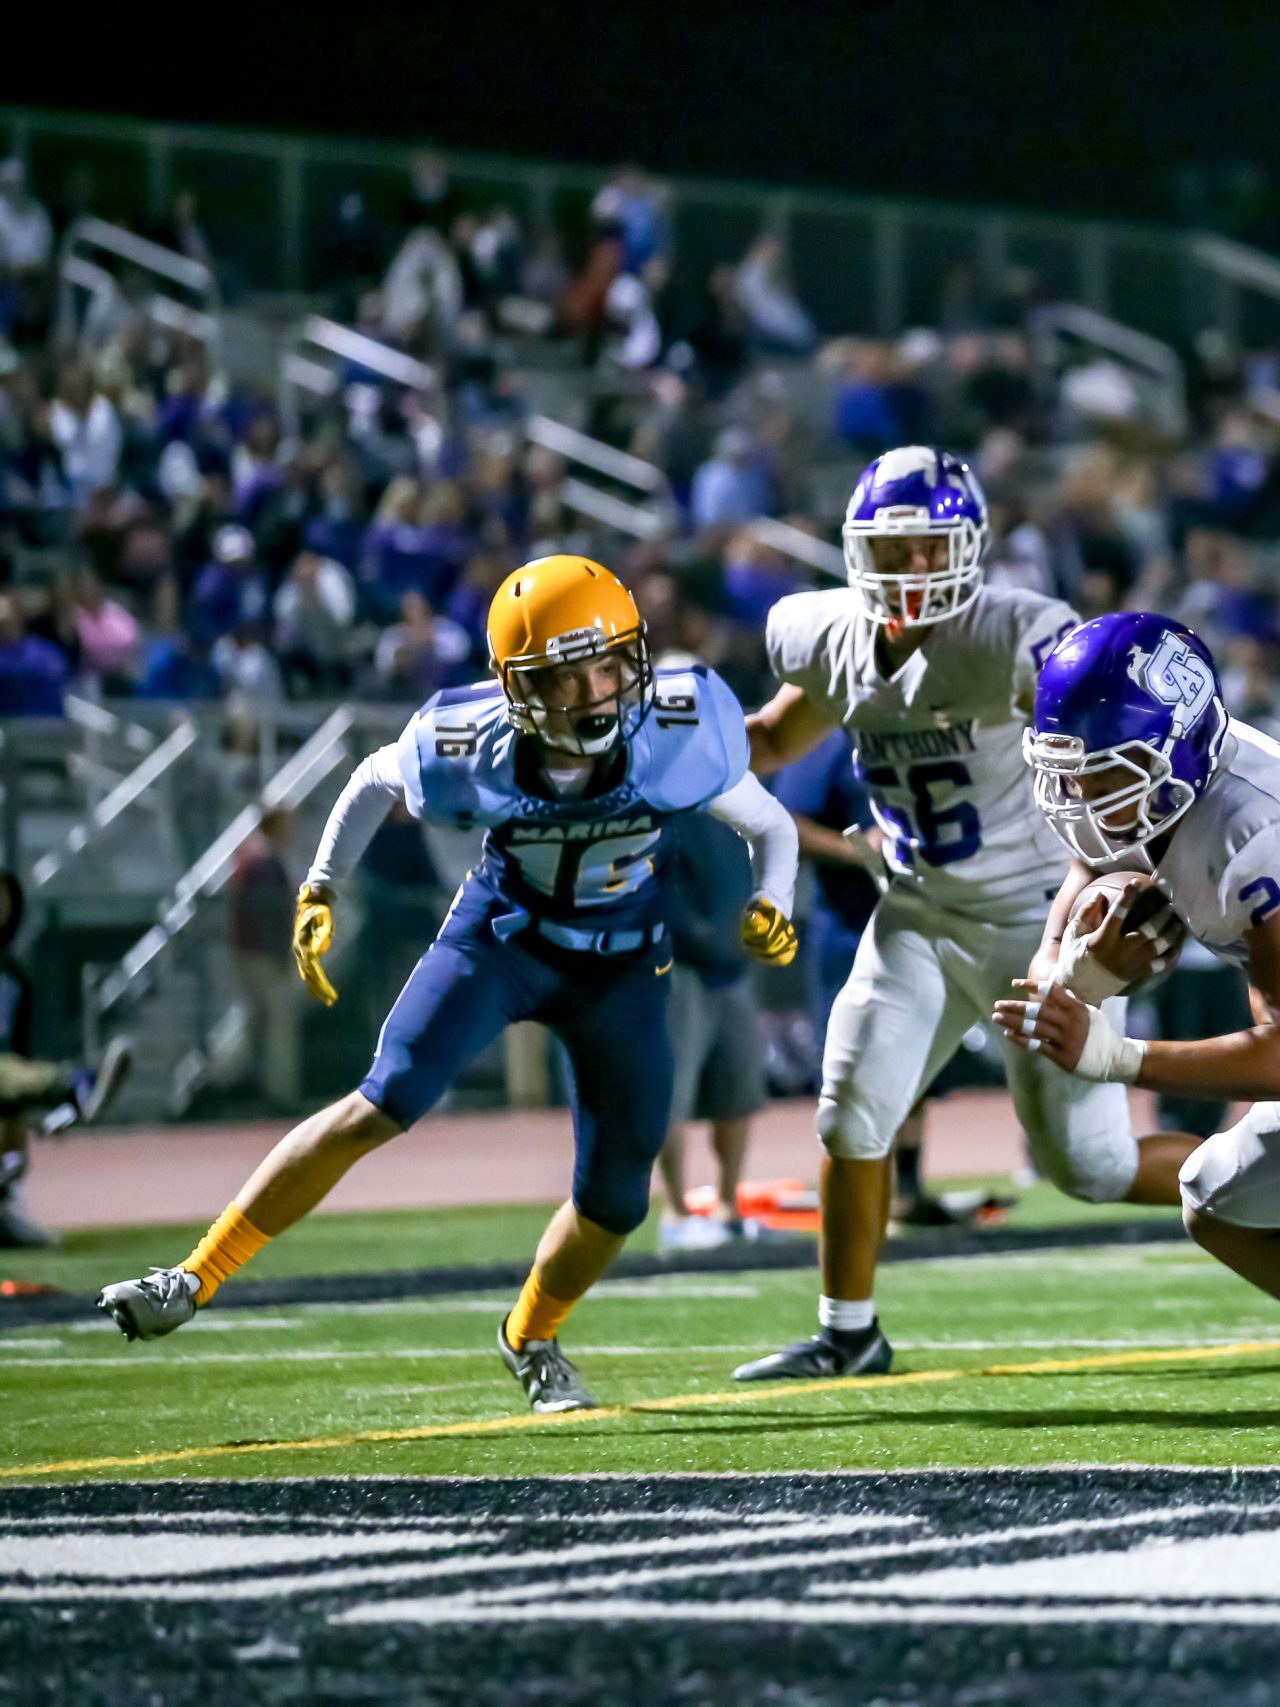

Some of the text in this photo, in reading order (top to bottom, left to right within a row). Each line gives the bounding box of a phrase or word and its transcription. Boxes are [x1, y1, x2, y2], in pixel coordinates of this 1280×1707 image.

[653, 695, 700, 729] 16
[435, 722, 477, 757] 16
[512, 815, 652, 841] MARINA
